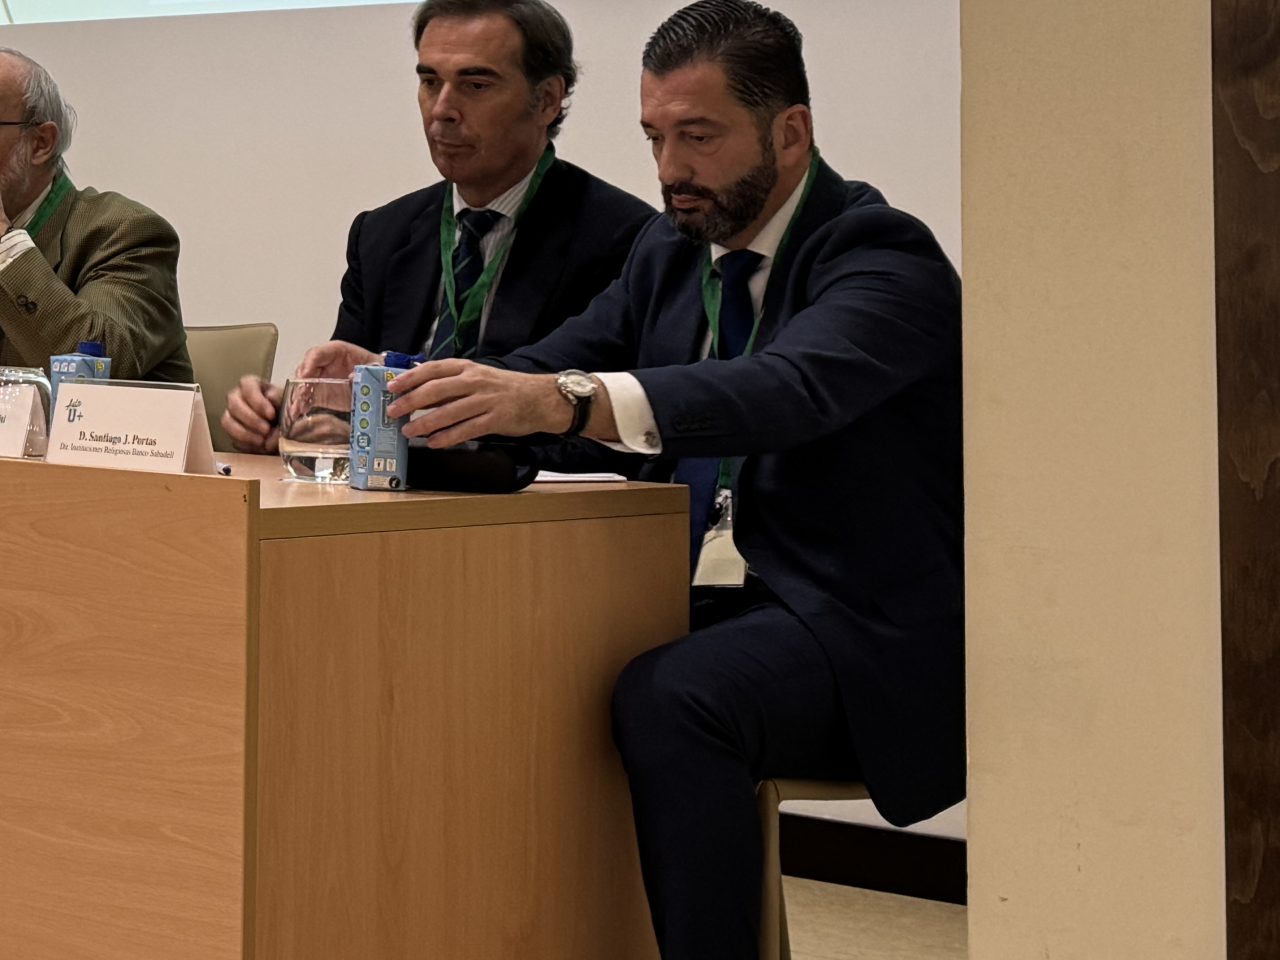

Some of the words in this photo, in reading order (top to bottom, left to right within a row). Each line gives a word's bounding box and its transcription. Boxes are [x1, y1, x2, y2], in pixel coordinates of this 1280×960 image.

[79, 431, 87, 441] D.
[89, 431, 121, 444] Santiago
[122, 434, 130, 445] J.
